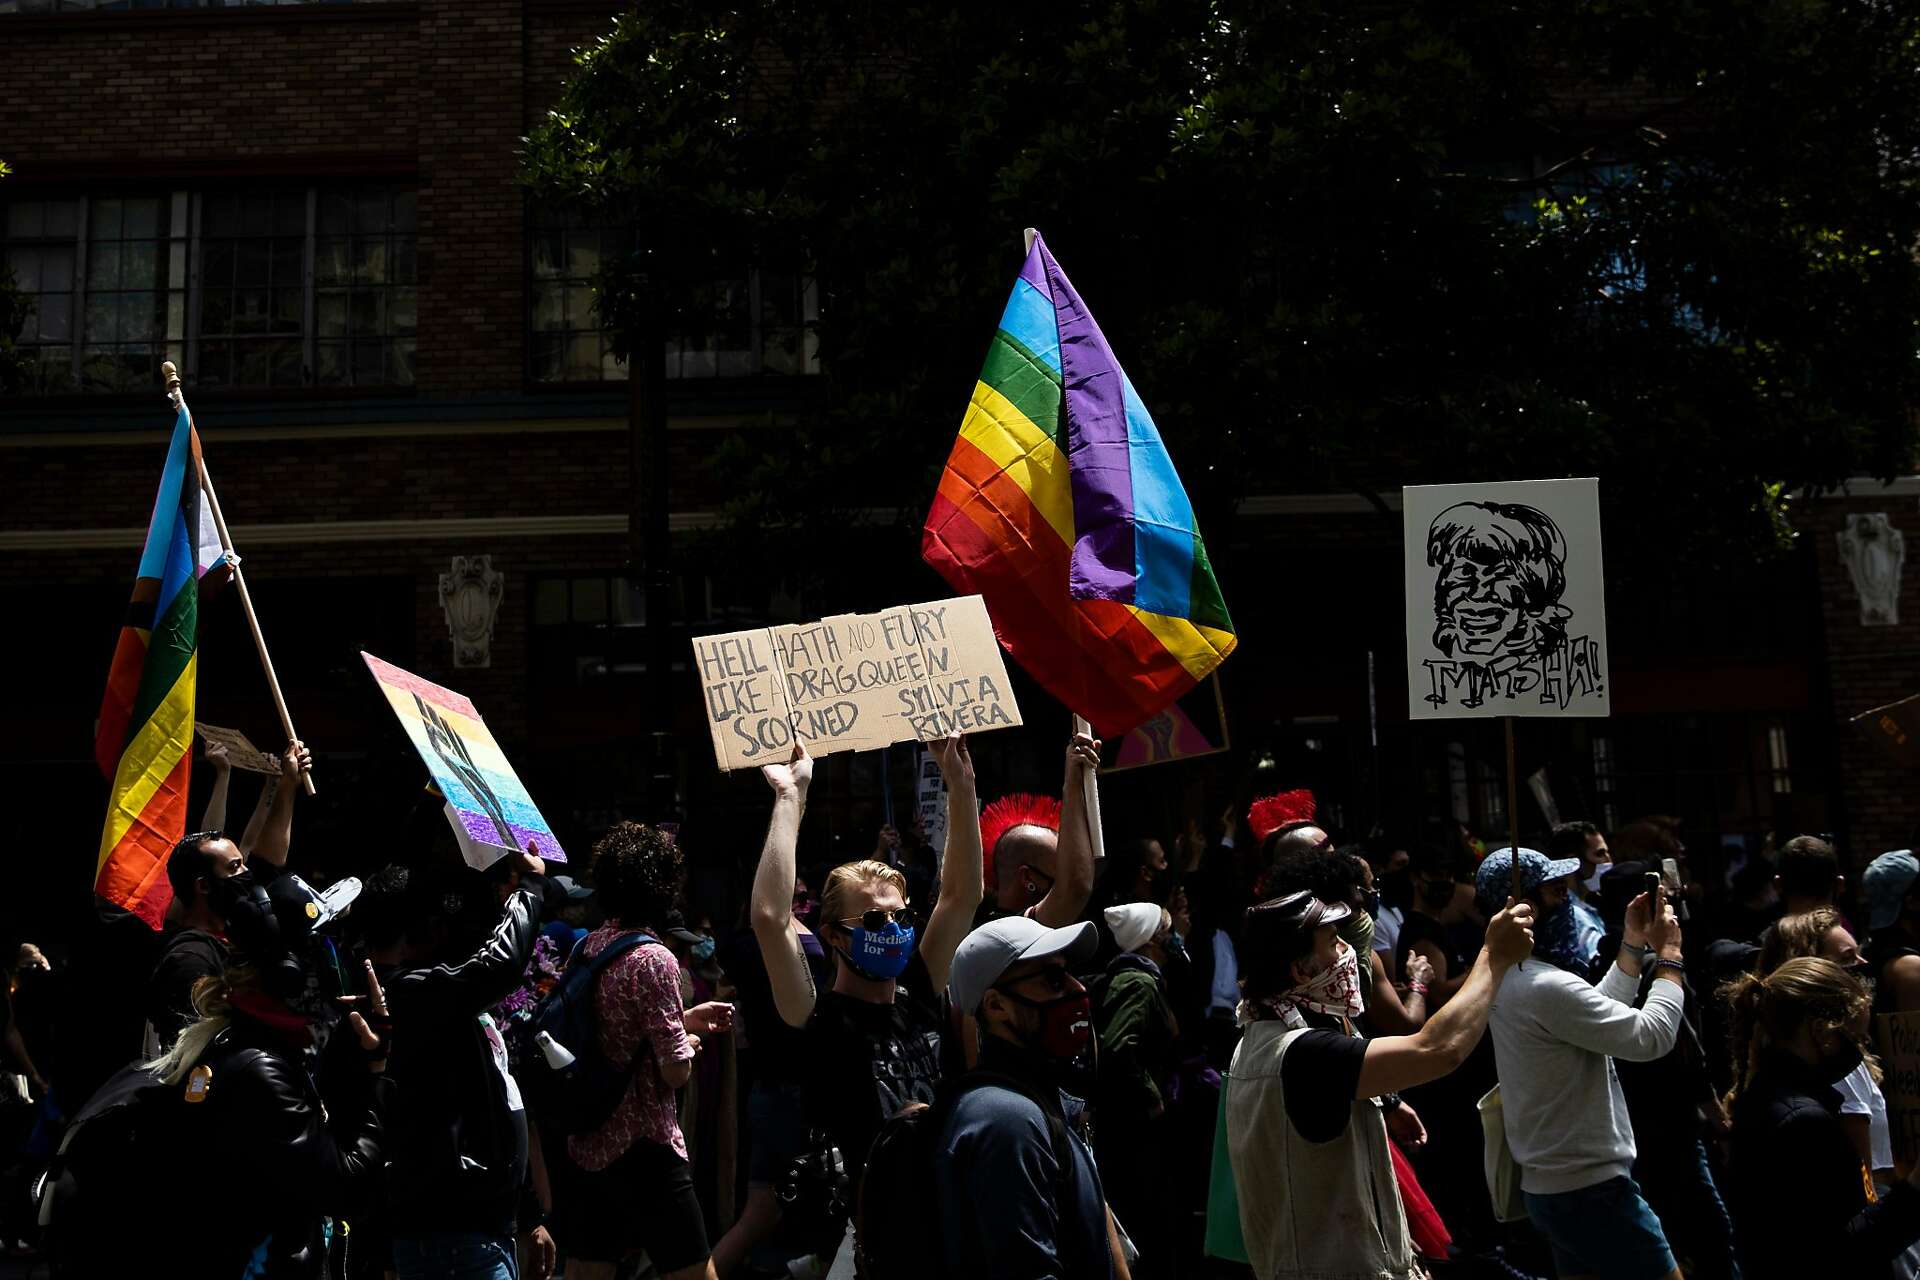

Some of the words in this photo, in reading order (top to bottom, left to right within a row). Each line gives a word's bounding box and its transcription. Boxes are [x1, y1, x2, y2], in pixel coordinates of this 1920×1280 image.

[698, 638, 768, 681] HELL
[769, 626, 843, 668] HATH
[847, 621, 875, 654] NO
[880, 607, 947, 651] FURY
[706, 677, 768, 722] LIKE
[771, 674, 786, 706] A
[908, 703, 1013, 741] RIVERA
[733, 701, 859, 757] SCORNED
[864, 942, 885, 955] for
